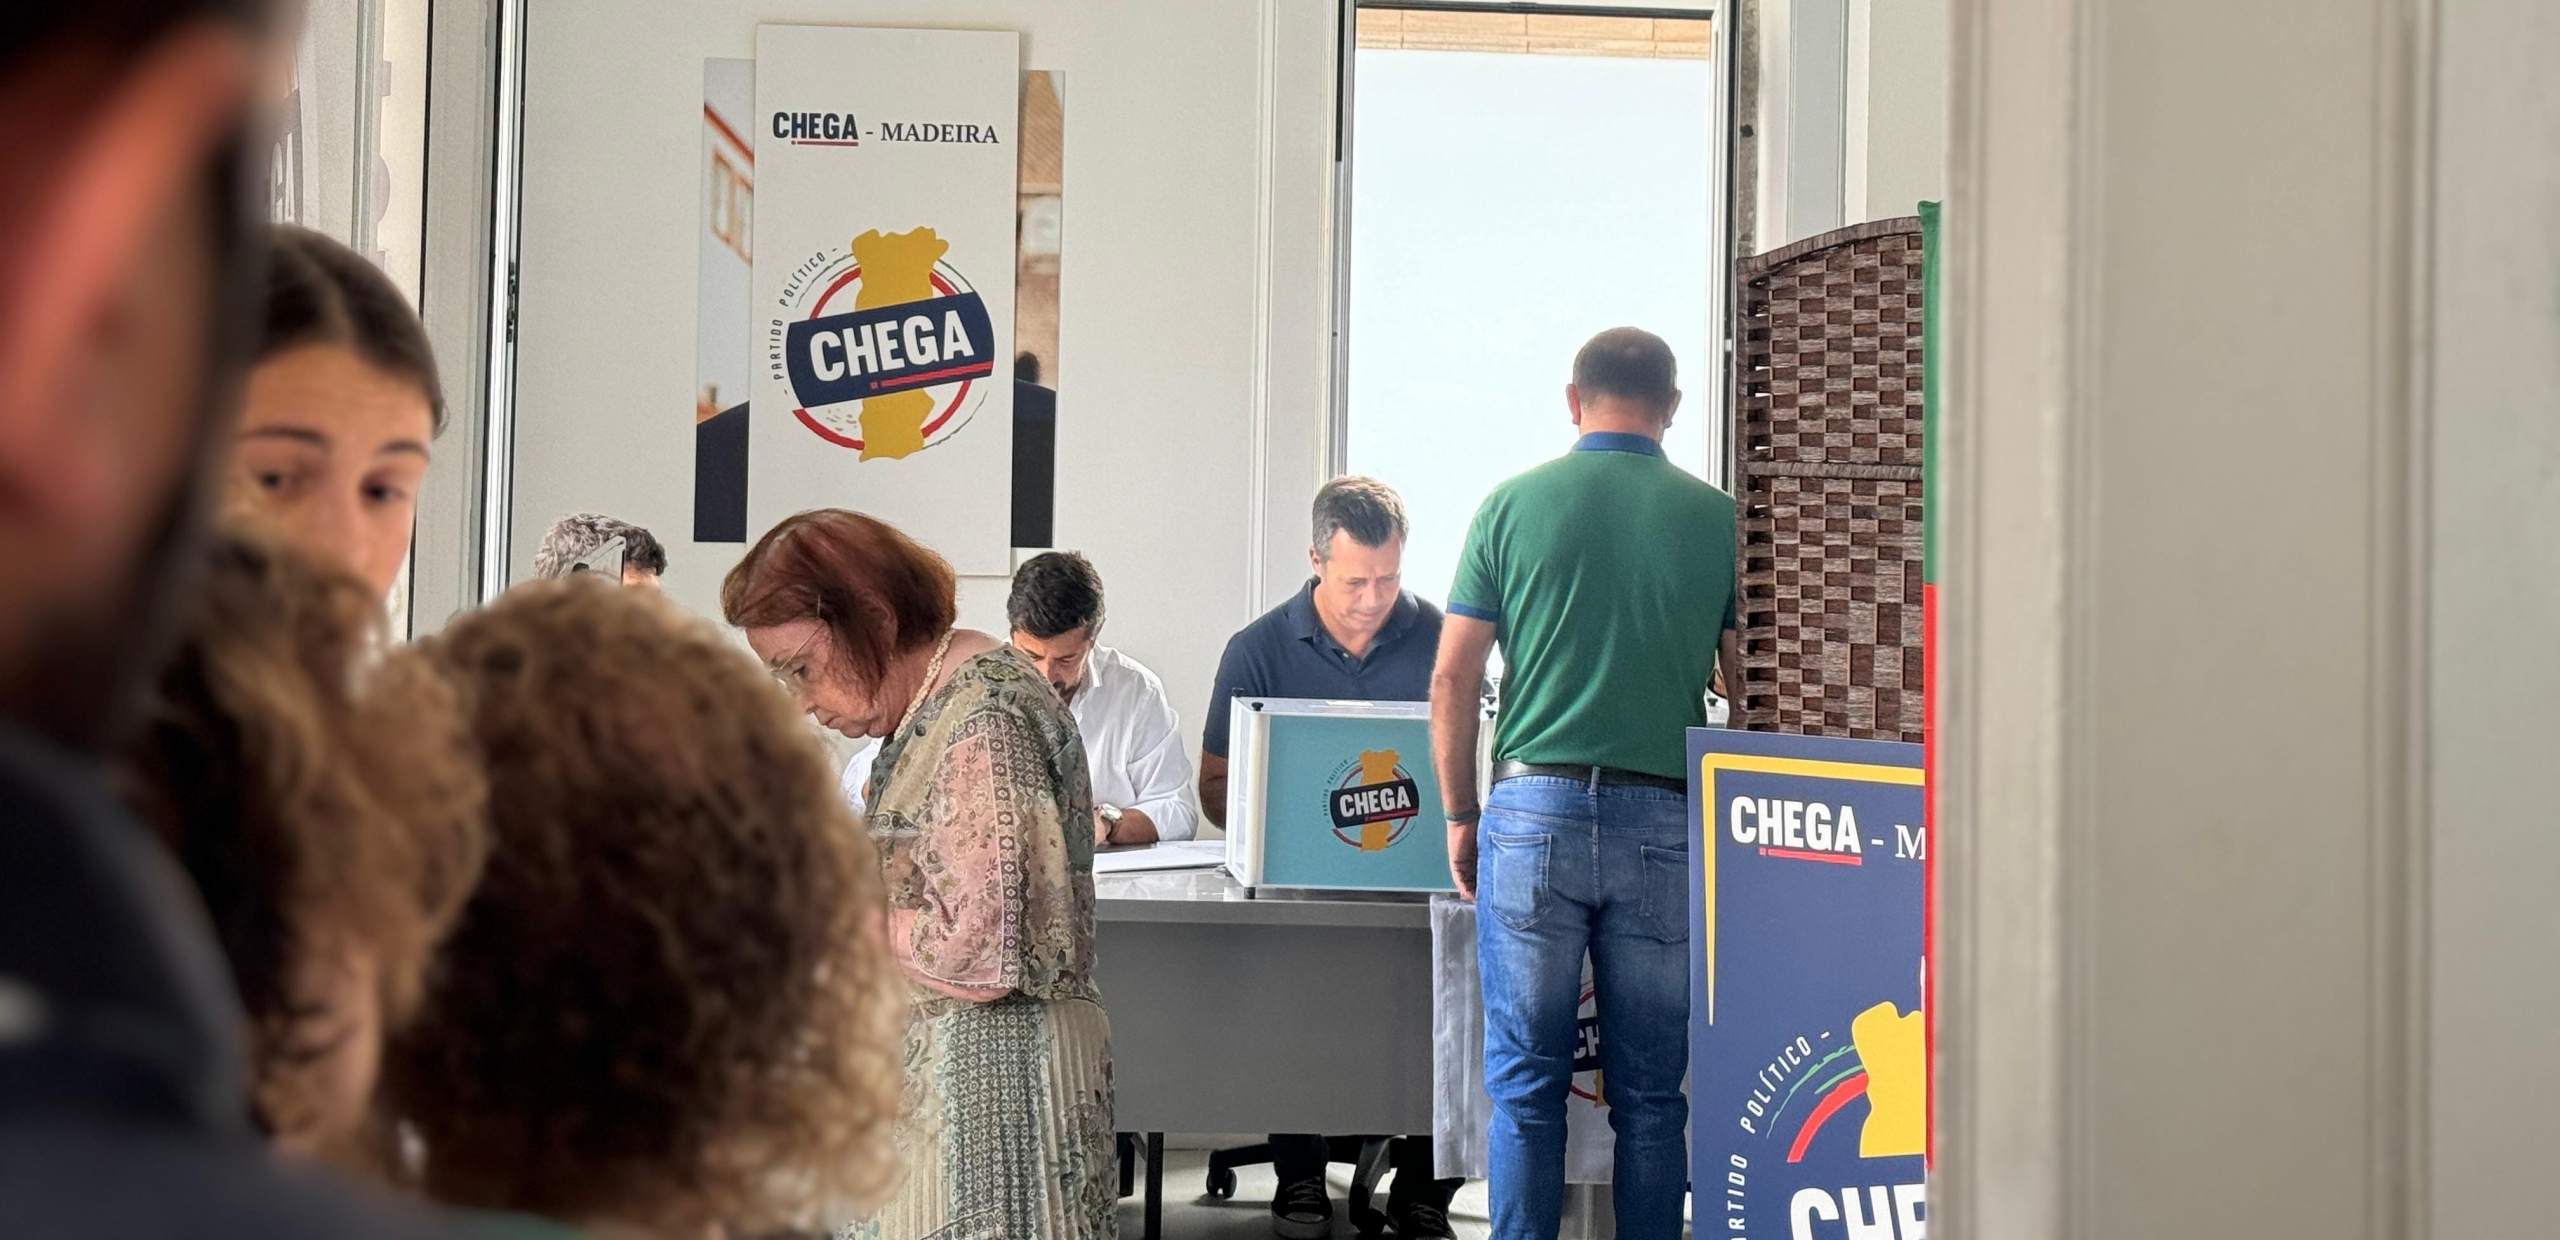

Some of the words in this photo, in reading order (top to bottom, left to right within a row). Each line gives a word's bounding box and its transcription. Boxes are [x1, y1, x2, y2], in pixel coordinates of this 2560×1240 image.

[773, 111, 859, 140] CHEGA
[880, 122, 1000, 144] MADEIRA
[770, 319, 784, 381] PARTIDO
[779, 251, 826, 307] POLÍTICO
[809, 309, 975, 383] CHEGA
[1339, 785, 1412, 818] CHEGA
[1731, 796, 1862, 854] CHEGA
[1727, 1153, 1748, 1240] RTIDO
[1740, 1036, 1812, 1135] POLÍTICO
